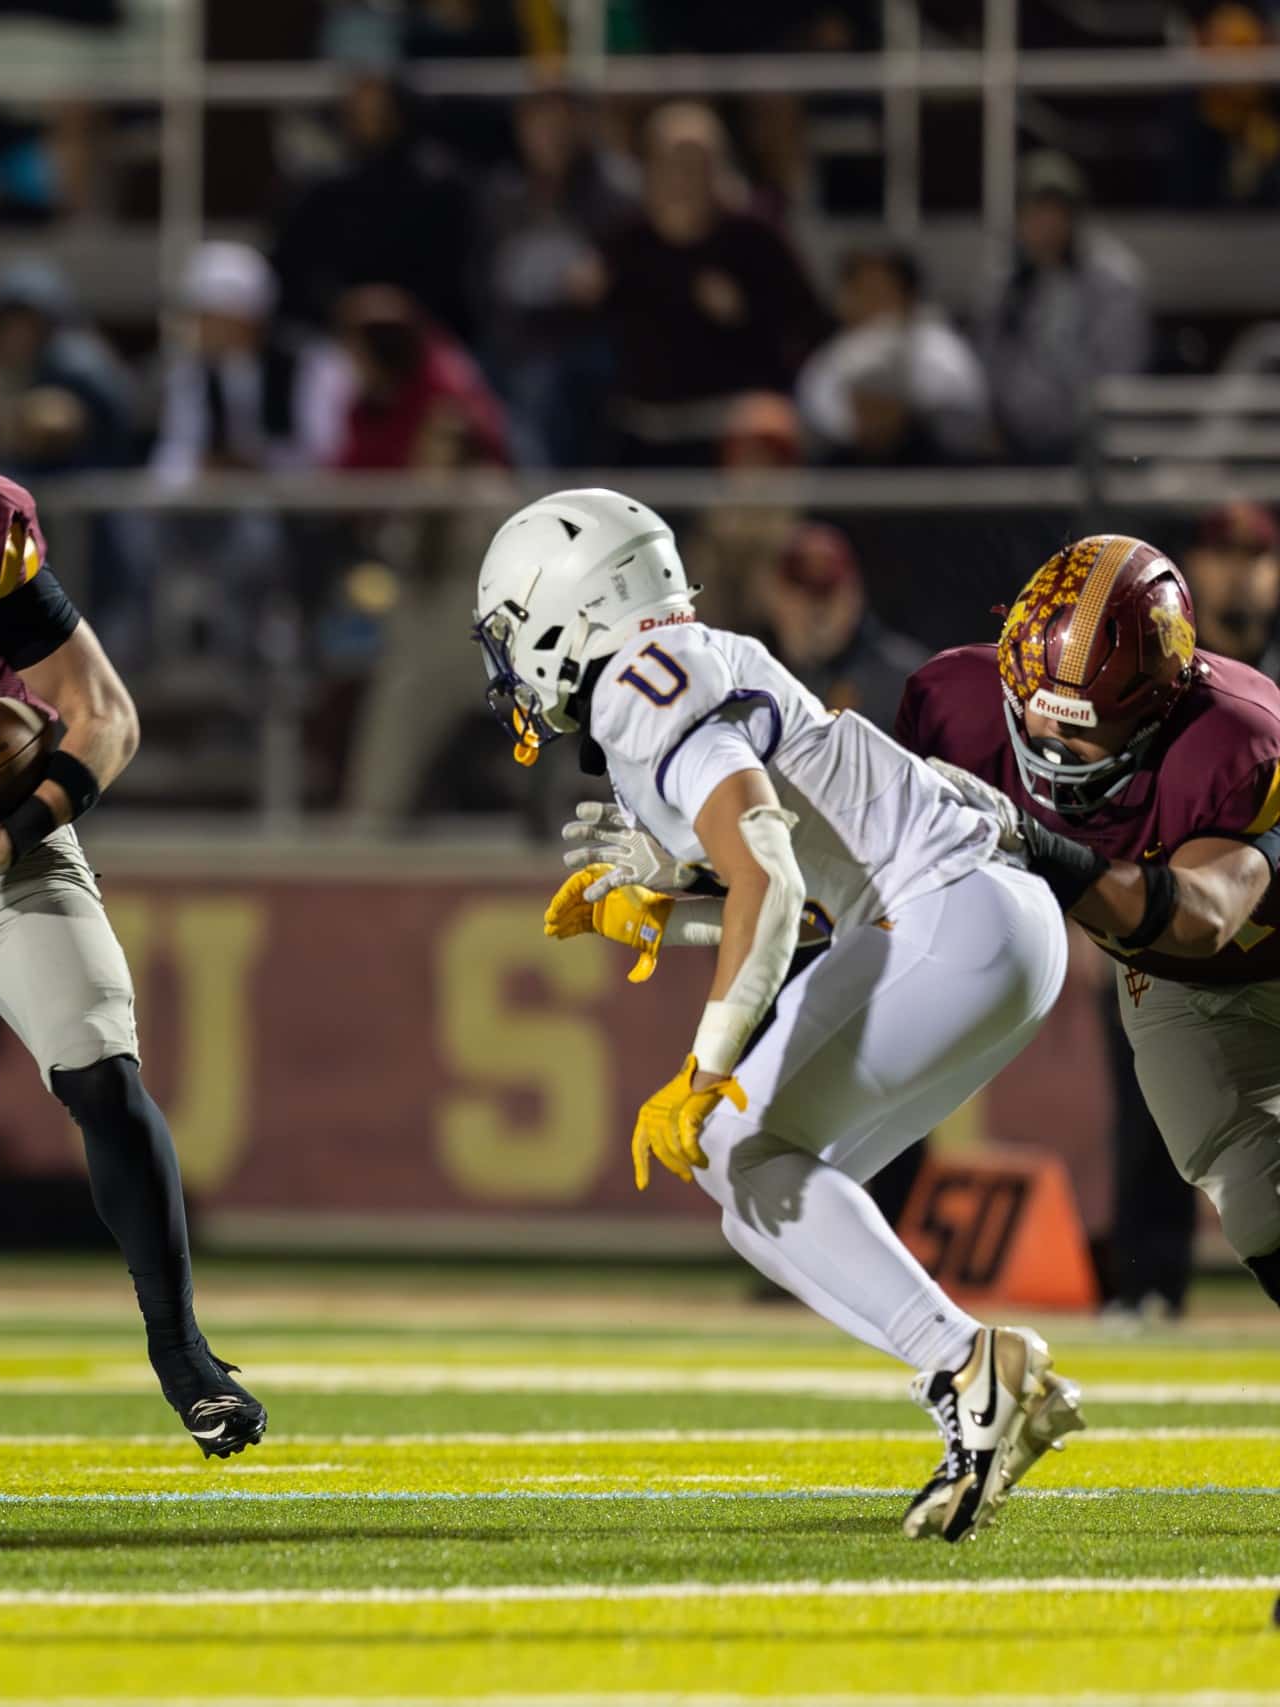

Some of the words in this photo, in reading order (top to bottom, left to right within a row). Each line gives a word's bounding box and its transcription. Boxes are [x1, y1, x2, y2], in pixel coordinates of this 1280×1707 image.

[616, 642, 689, 709] U
[1035, 697, 1091, 722] Riddell
[912, 1170, 1035, 1289] 50
